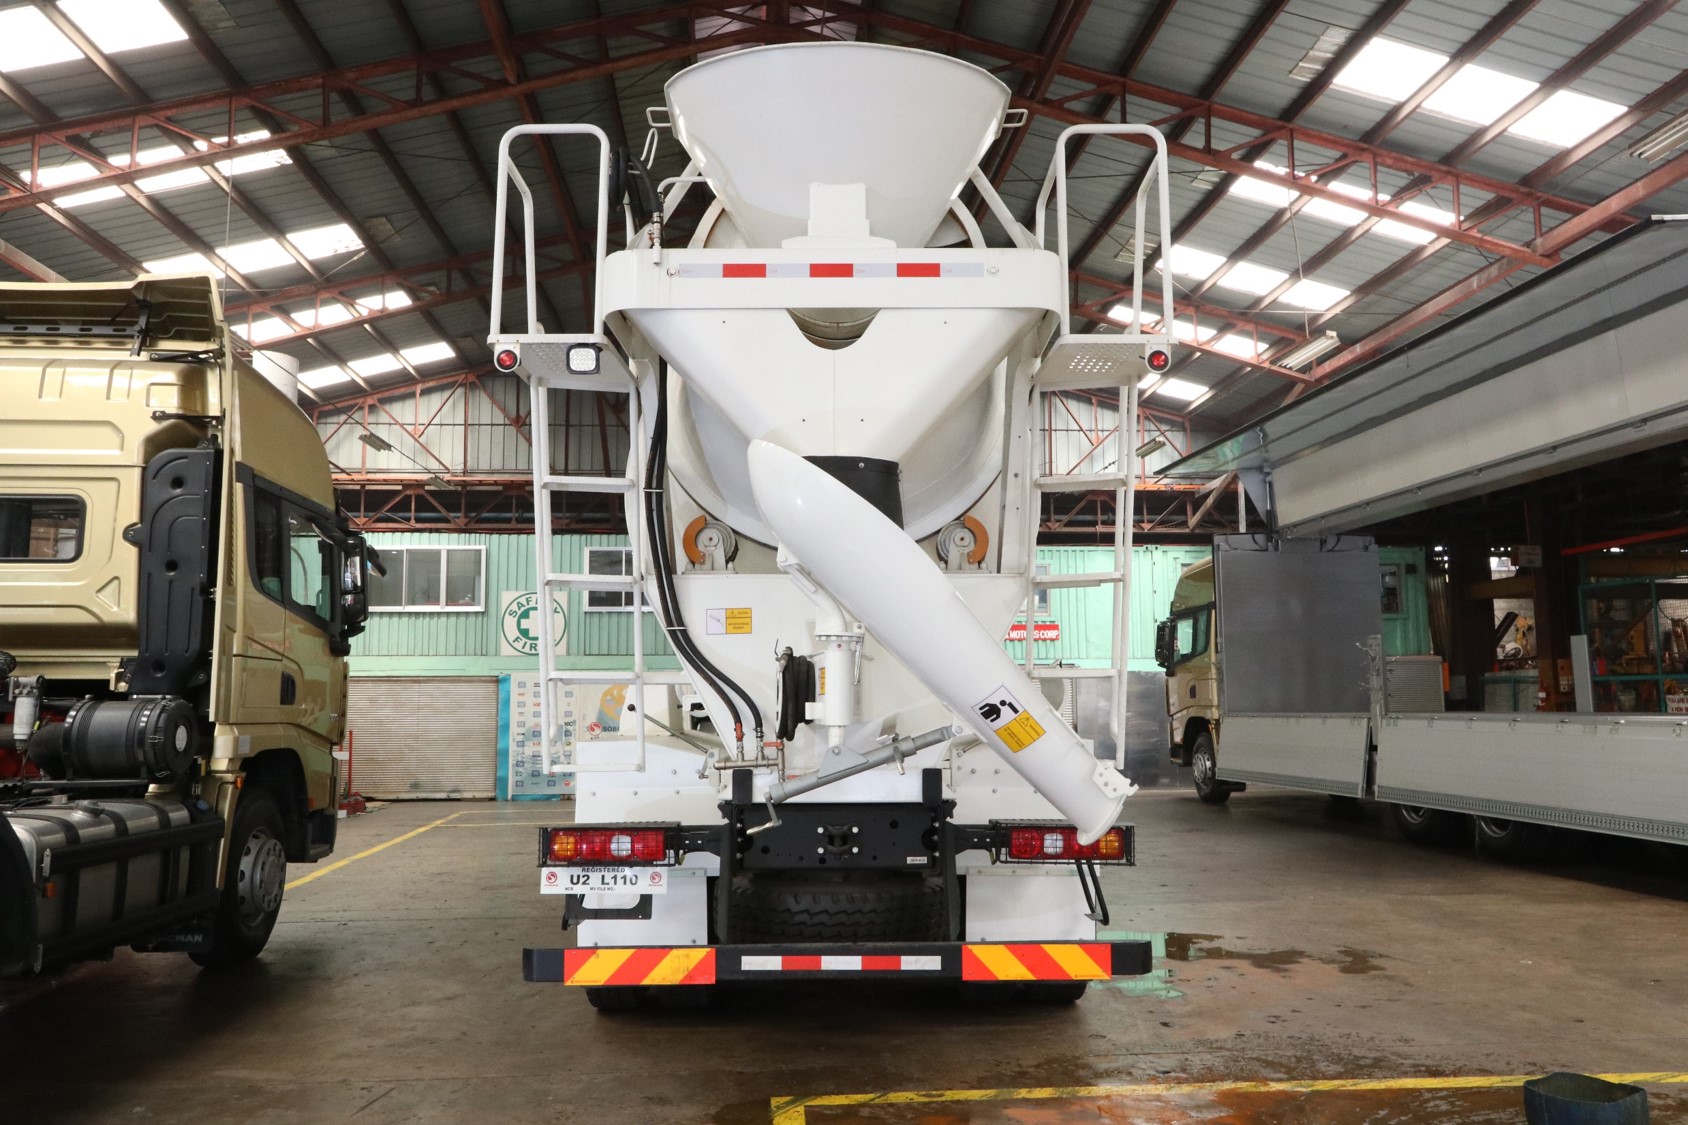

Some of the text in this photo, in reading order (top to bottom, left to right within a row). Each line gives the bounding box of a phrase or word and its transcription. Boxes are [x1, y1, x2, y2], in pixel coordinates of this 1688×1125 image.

[508, 596, 561, 618] SAFY
[1010, 630, 1040, 639] MOTS
[1040, 630, 1060, 639] CORP.
[602, 725, 620, 733] SOBI
[570, 874, 638, 885] U2 L110
